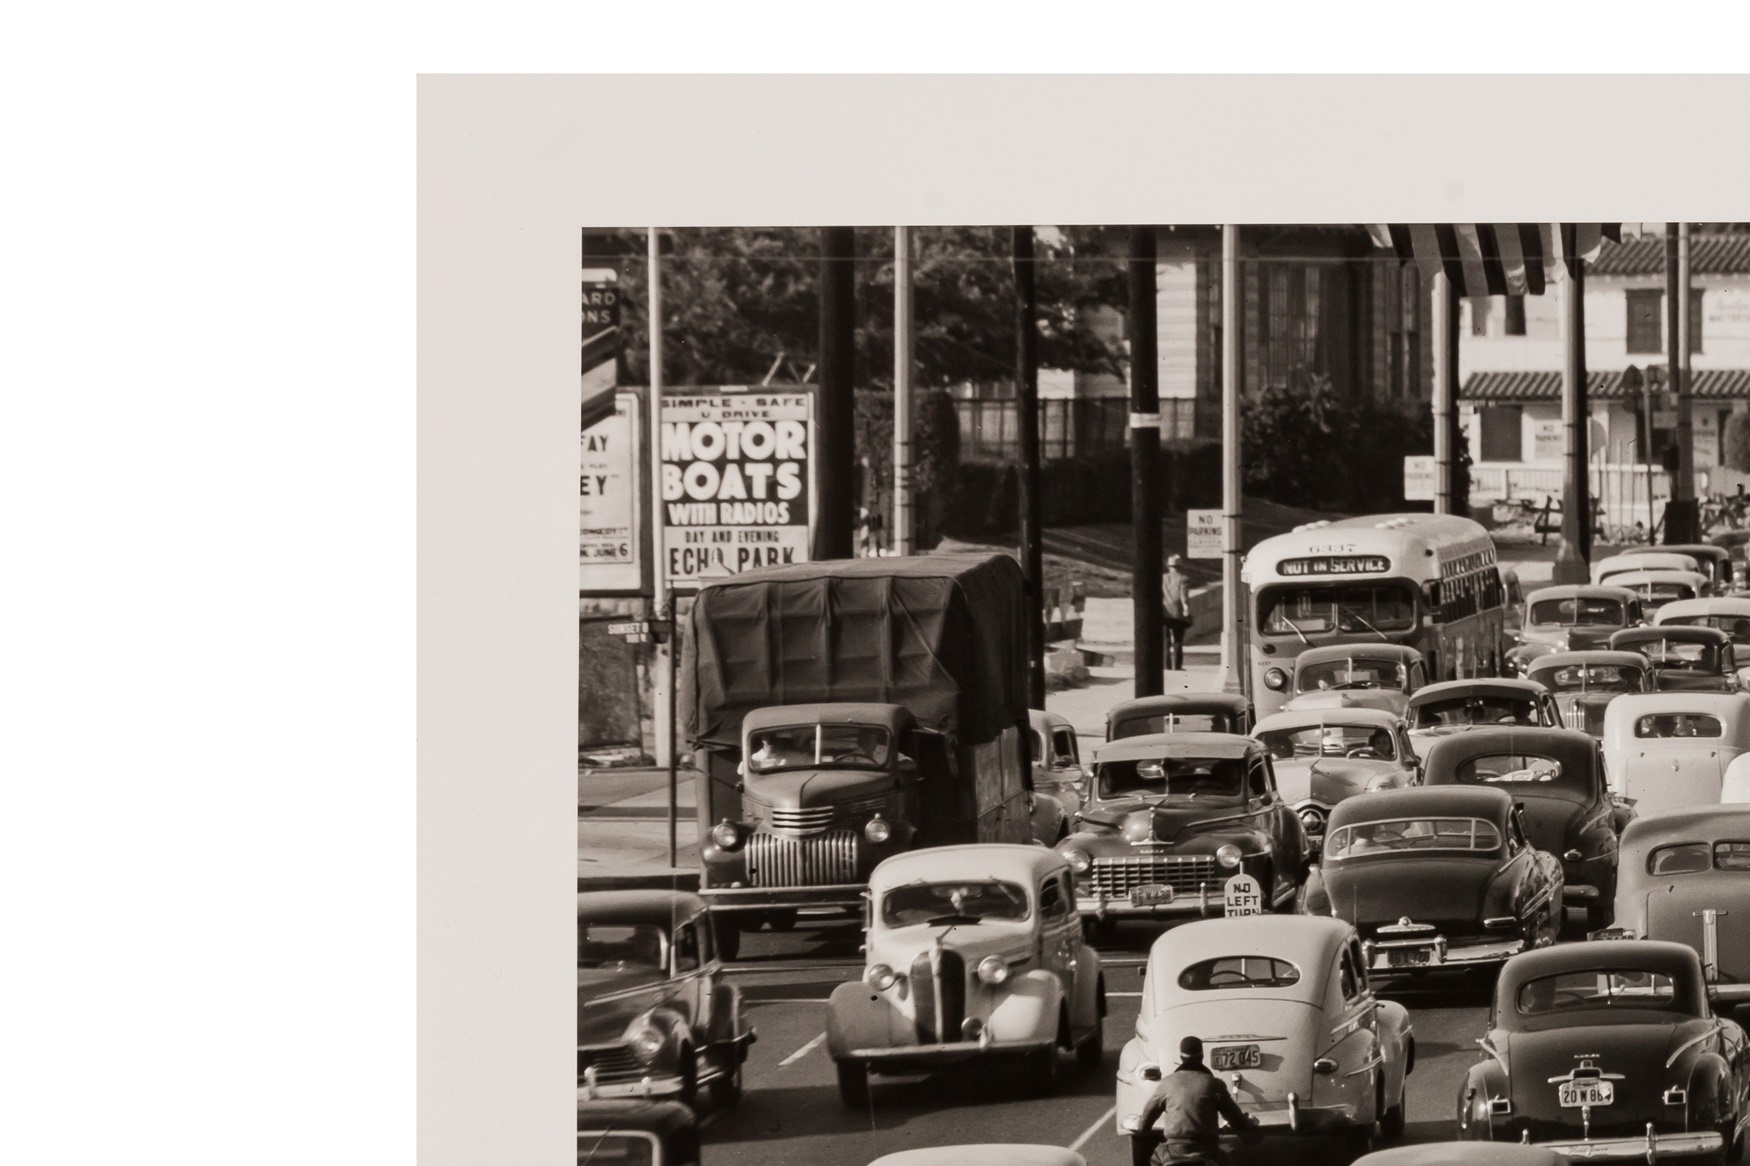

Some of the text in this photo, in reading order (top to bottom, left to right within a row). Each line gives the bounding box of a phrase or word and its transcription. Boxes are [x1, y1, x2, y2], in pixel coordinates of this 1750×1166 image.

[663, 398, 805, 408] SIMPLE SAFE
[722, 410, 770, 418] DRIVE
[662, 421, 807, 461] MOTOR
[662, 461, 802, 501] BOATS
[668, 502, 790, 526] WITH RADIOS
[1199, 515, 1213, 525] NO
[685, 530, 780, 543] DAY AND EVENING
[619, 543, 628, 557] 6
[737, 546, 795, 574] PARK
[1283, 558, 1386, 575] NOT IN SERVICE
[1233, 882, 1251, 894] NO
[1227, 895, 1259, 907] LEFT
[1563, 1090, 1578, 1104] 20
